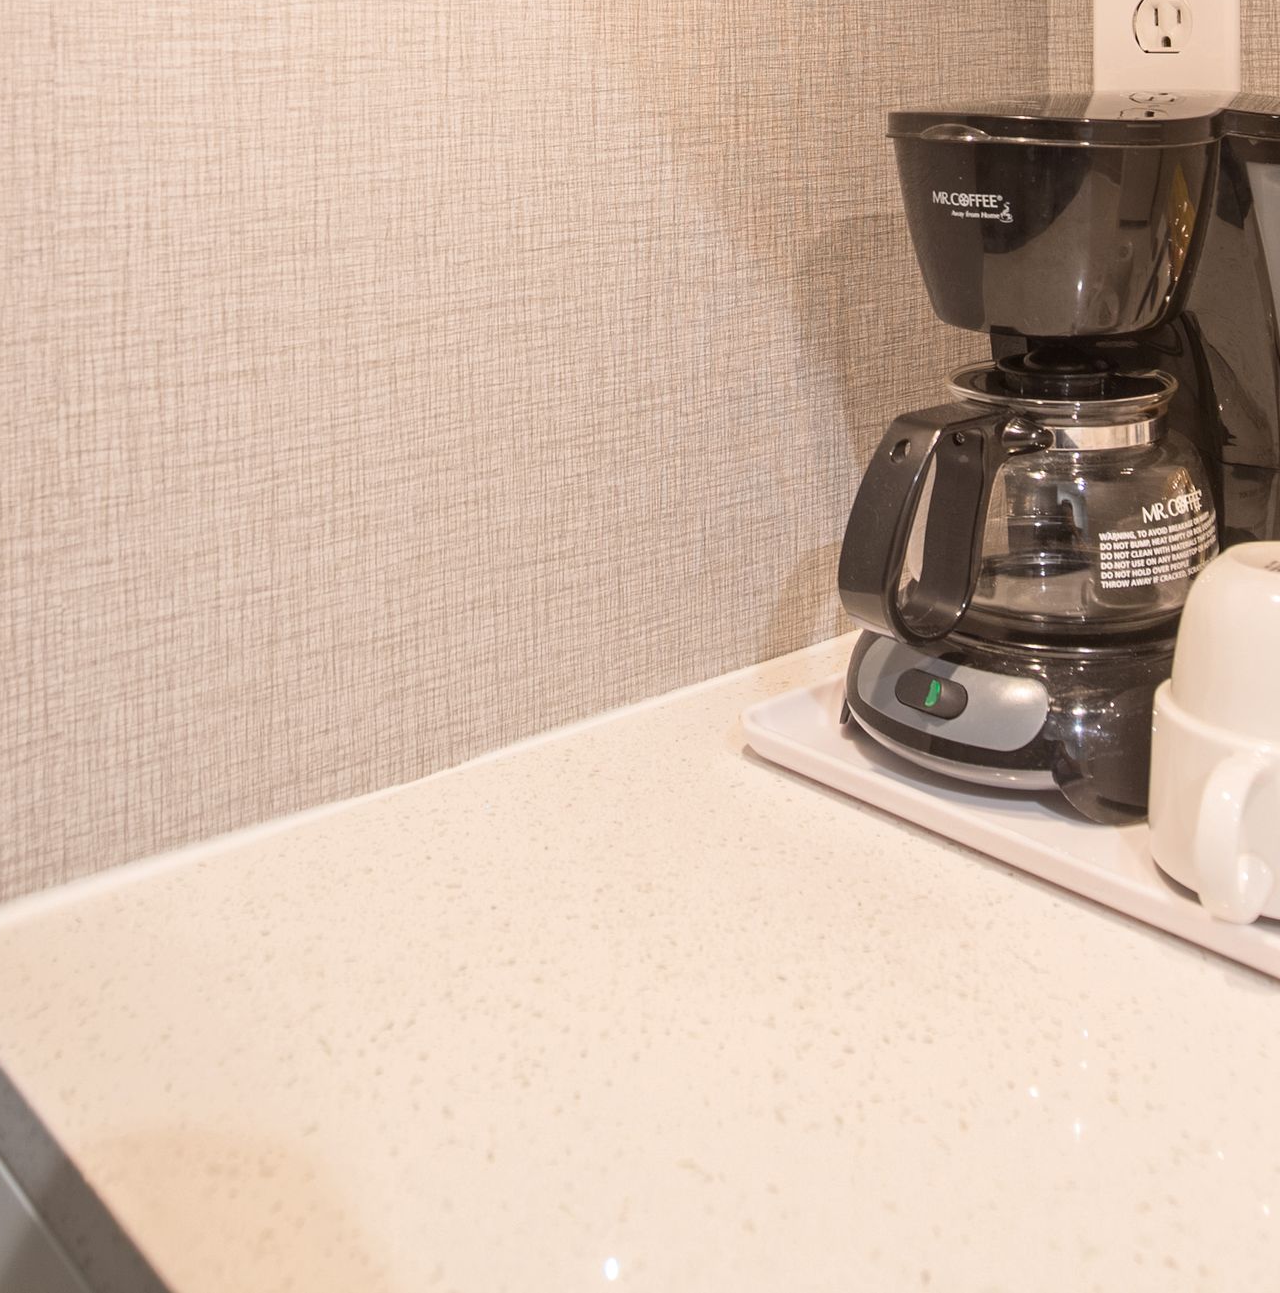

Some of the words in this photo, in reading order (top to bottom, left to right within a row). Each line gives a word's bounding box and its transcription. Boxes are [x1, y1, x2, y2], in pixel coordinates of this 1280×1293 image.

[1137, 530, 1147, 539] TO
[1148, 526, 1168, 537] AVOID
[1100, 542, 1112, 551] DO
[1113, 542, 1129, 550] NOT
[1152, 536, 1168, 546] HEAT
[1100, 552, 1113, 560] DO
[1113, 551, 1130, 560] NOT
[1131, 549, 1153, 559] CLEAN
[1154, 545, 1170, 556] WITH
[1101, 562, 1113, 570] DO
[1114, 561, 1130, 570] NOT
[1131, 559, 1145, 568] USE
[1146, 557, 1157, 566] ON
[1157, 555, 1171, 565] ANY
[1101, 571, 1113, 580] DO
[1114, 570, 1131, 579] NOT
[1132, 568, 1151, 577] HOLD
[1153, 565, 1170, 575] OVER
[1101, 580, 1130, 589] THROW
[1130, 577, 1152, 587] AWAY
[1153, 576, 1160, 584] IF
